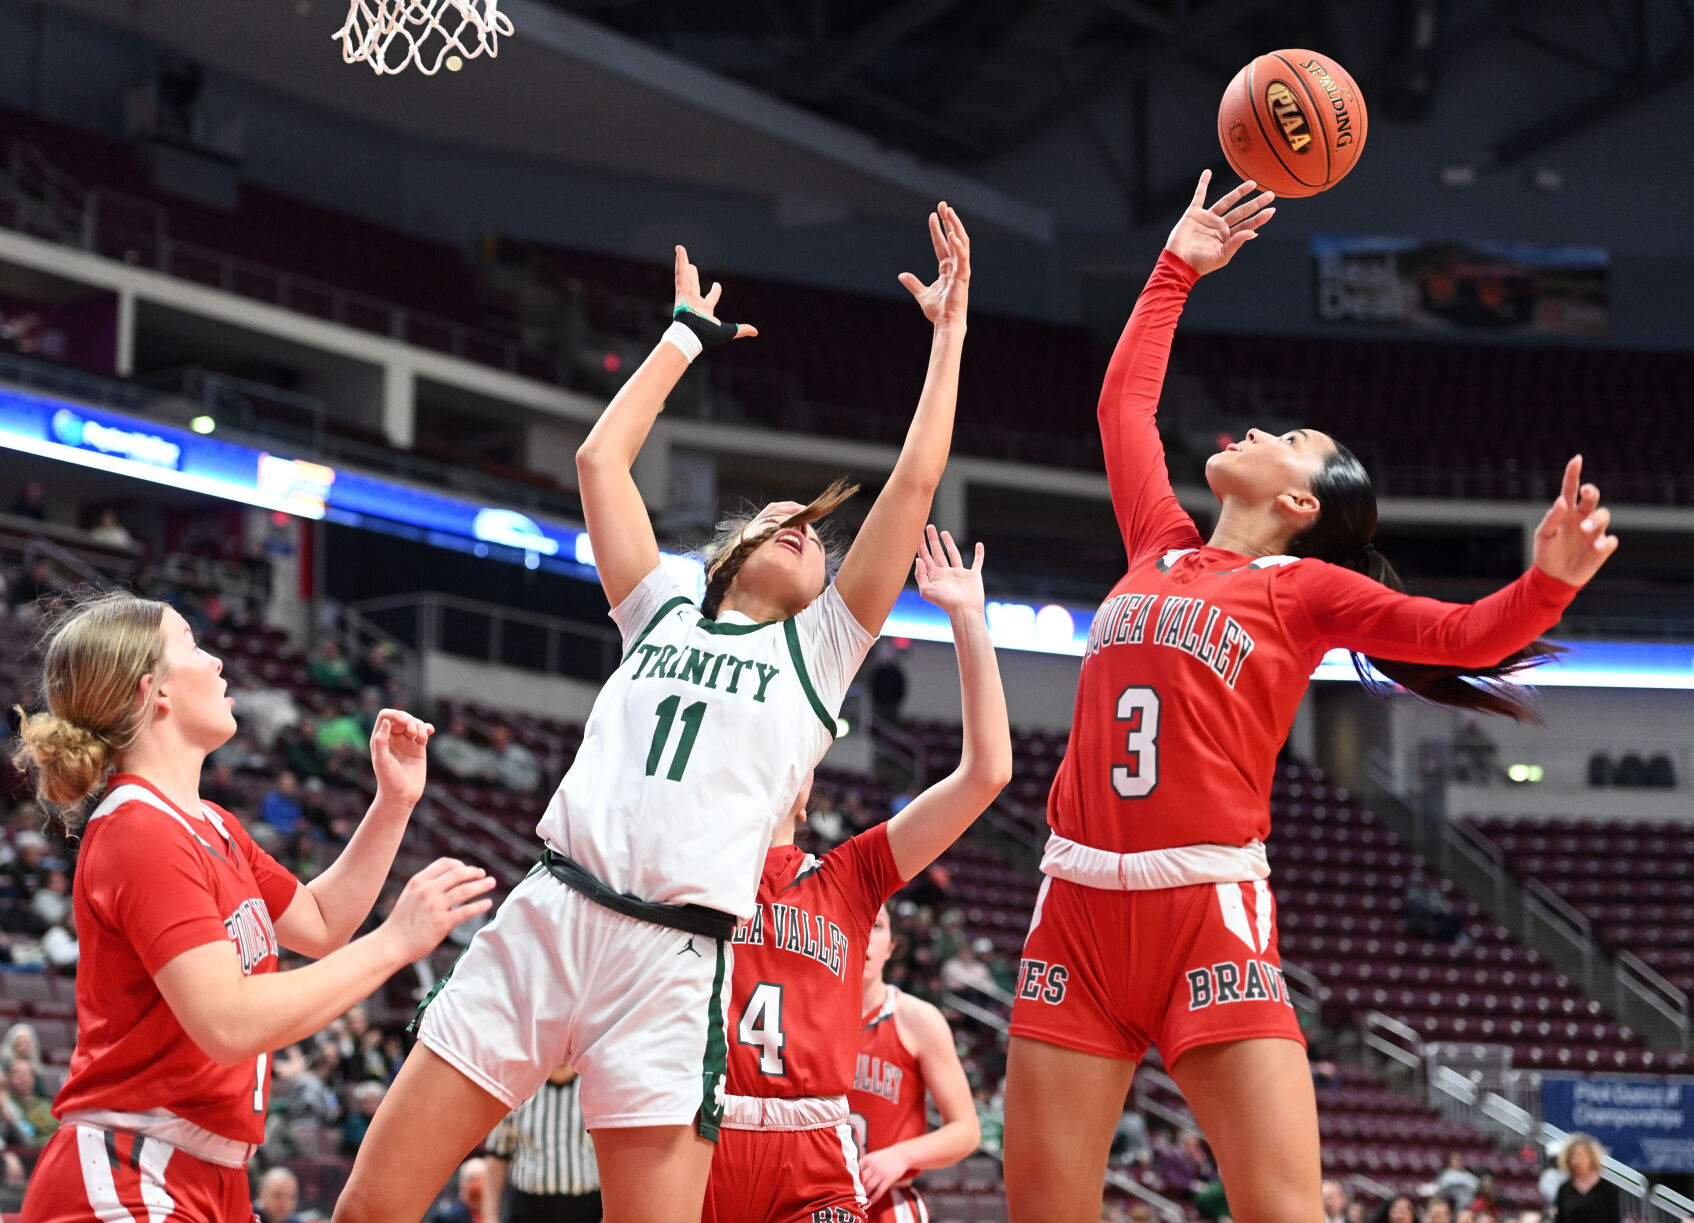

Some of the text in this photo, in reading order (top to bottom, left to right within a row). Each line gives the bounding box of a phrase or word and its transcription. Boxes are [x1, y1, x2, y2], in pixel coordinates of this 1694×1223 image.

[1267, 83, 1312, 151] PIAA
[1300, 59, 1353, 149] SPALDING
[631, 643, 780, 703] TRINITY
[1153, 595, 1255, 690] VALLEY
[645, 694, 707, 782] 11
[1110, 684, 1162, 799] 3
[771, 903, 848, 985] VALLEY
[737, 980, 787, 1078] 4
